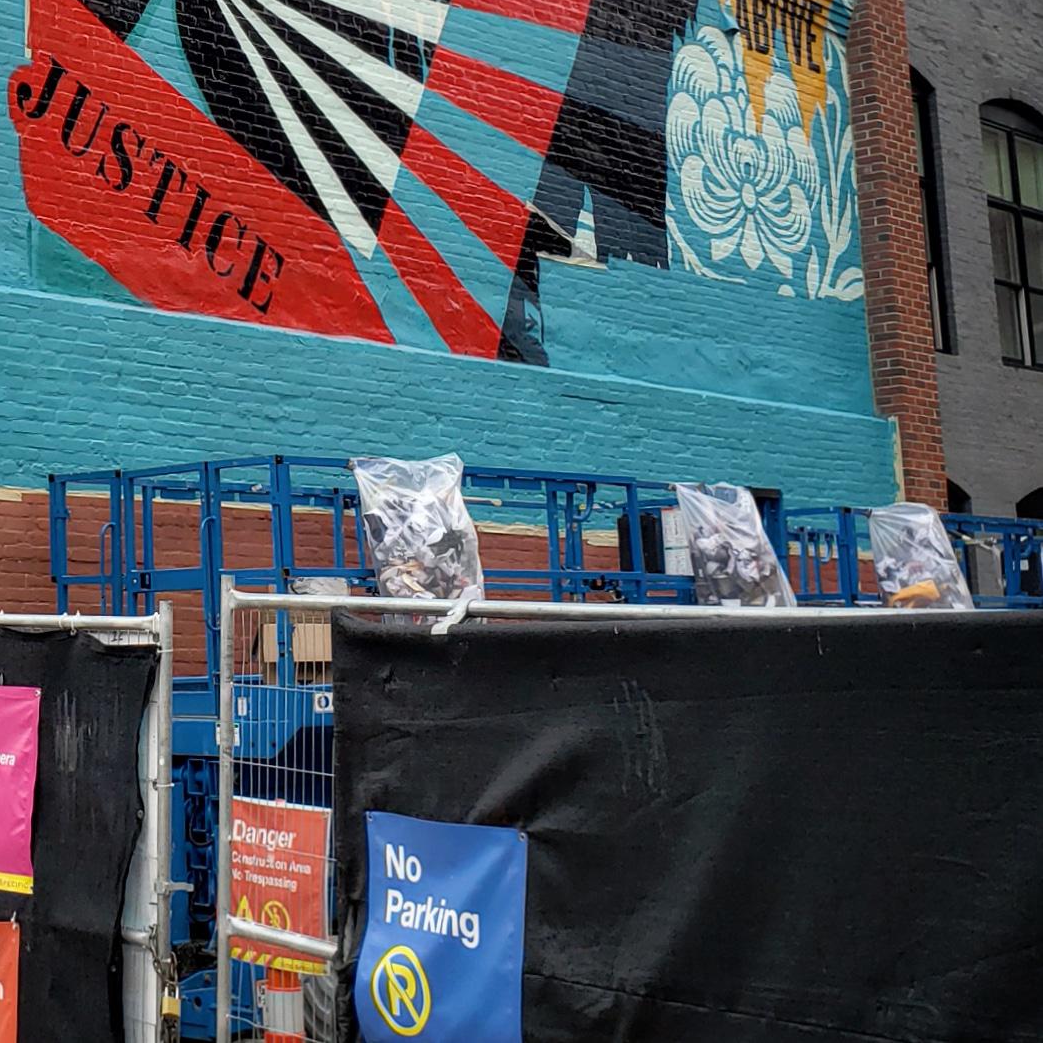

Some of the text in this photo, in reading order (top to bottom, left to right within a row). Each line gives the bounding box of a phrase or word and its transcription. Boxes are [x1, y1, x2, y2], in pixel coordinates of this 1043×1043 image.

[16, 56, 285, 314] JUSTICE
[233, 819, 296, 851] Danger
[385, 844, 422, 883] No
[385, 889, 479, 949] Parking
